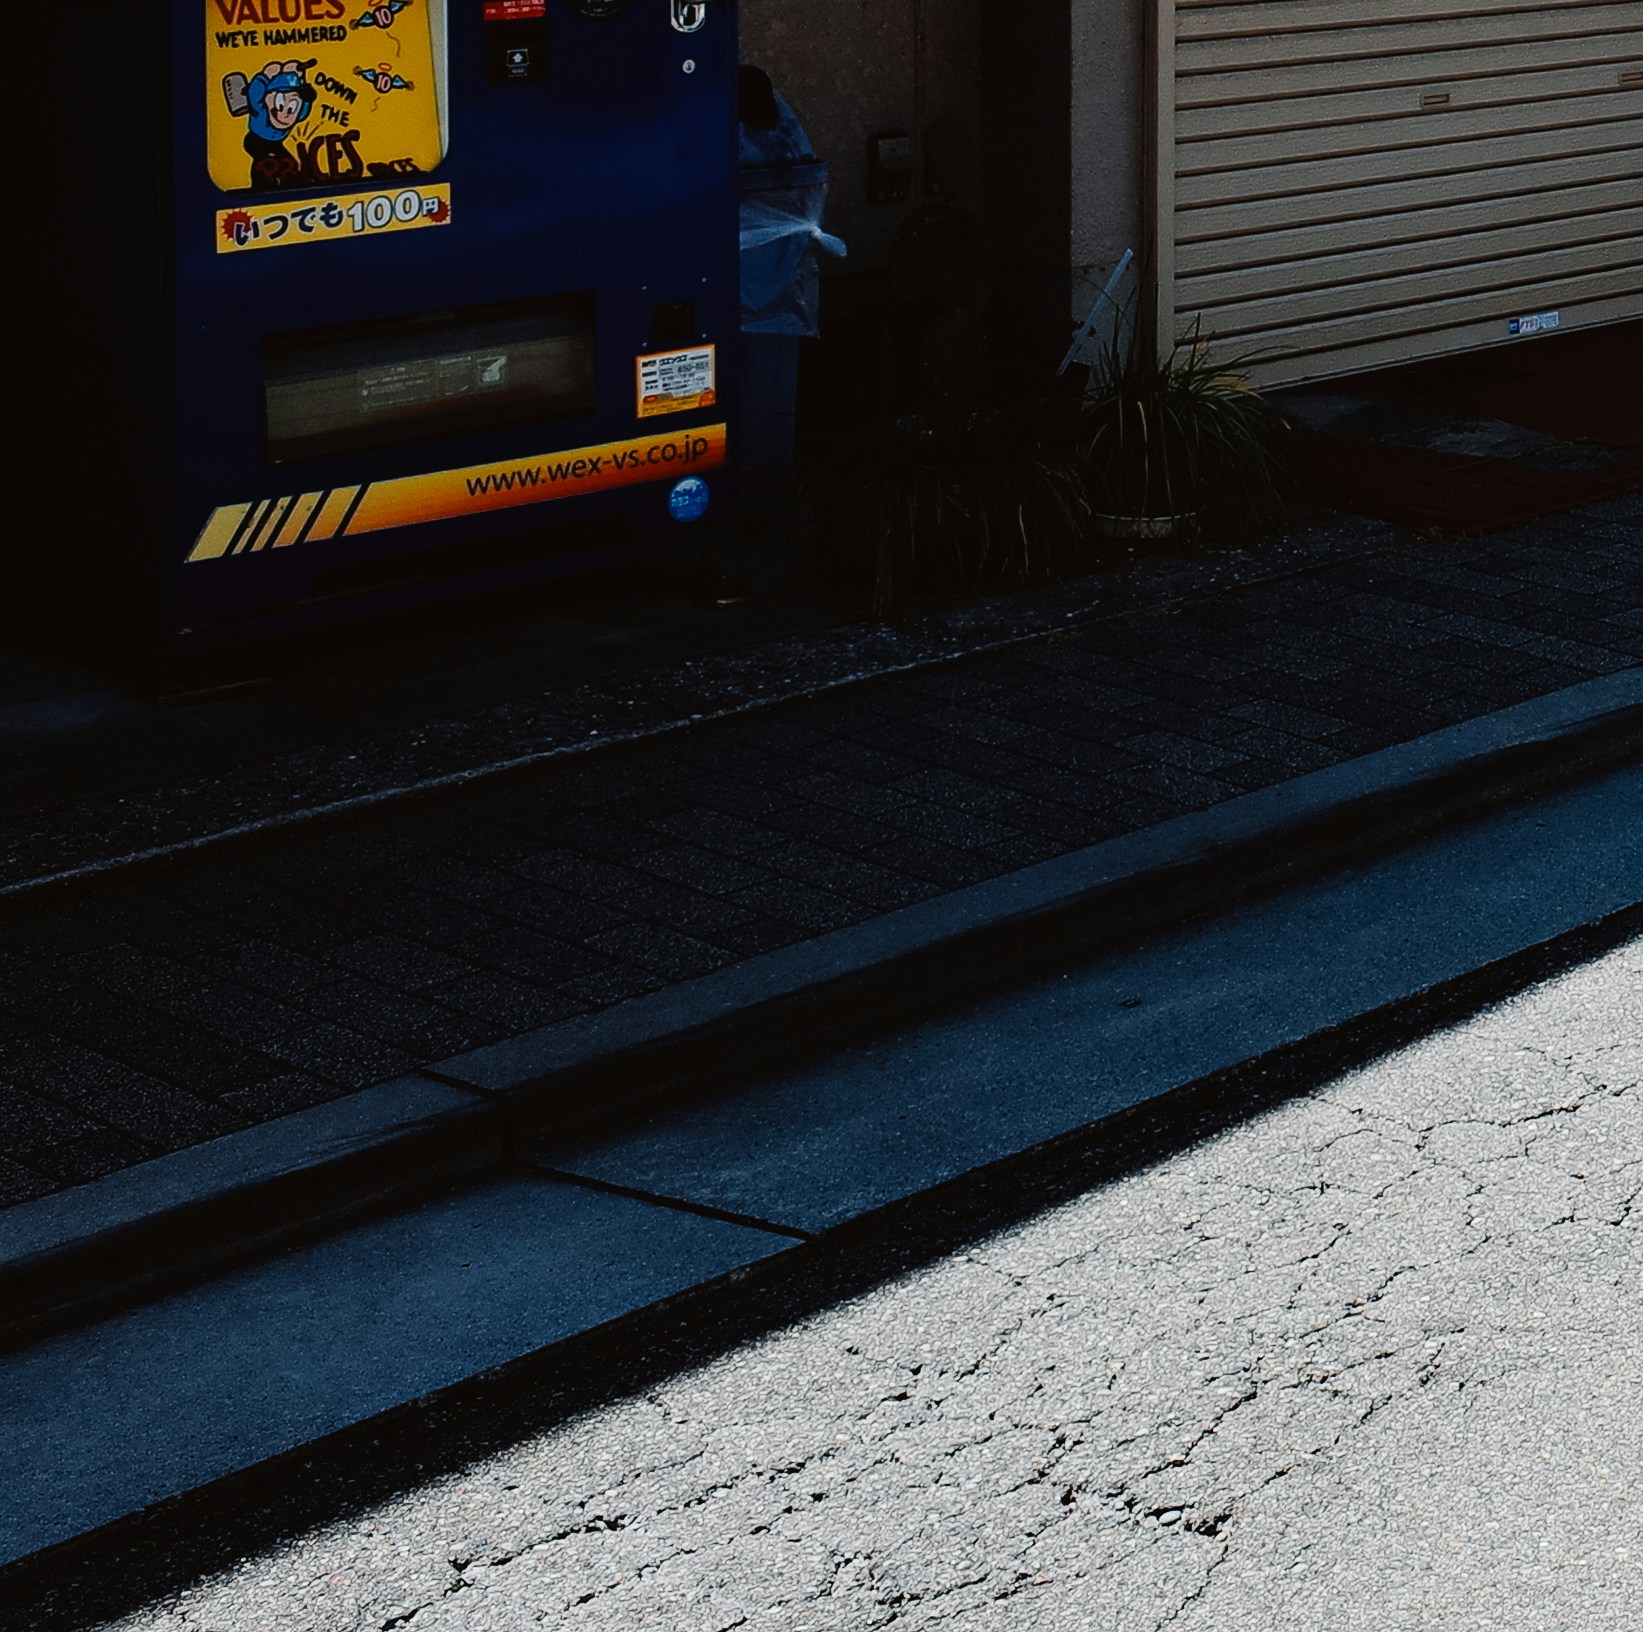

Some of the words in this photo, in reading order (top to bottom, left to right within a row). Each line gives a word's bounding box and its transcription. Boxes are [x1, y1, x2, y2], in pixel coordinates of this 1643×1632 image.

[376, 7, 392, 27] 10
[215, 30, 260, 49] WE'VE
[264, 25, 348, 46] HAMMERED
[314, 71, 358, 105] DOWN
[376, 74, 391, 93] 10
[320, 103, 350, 128] THE
[234, 189, 440, 247] いつでも100円
[466, 433, 709, 498] www.wex-vs.co.jp
